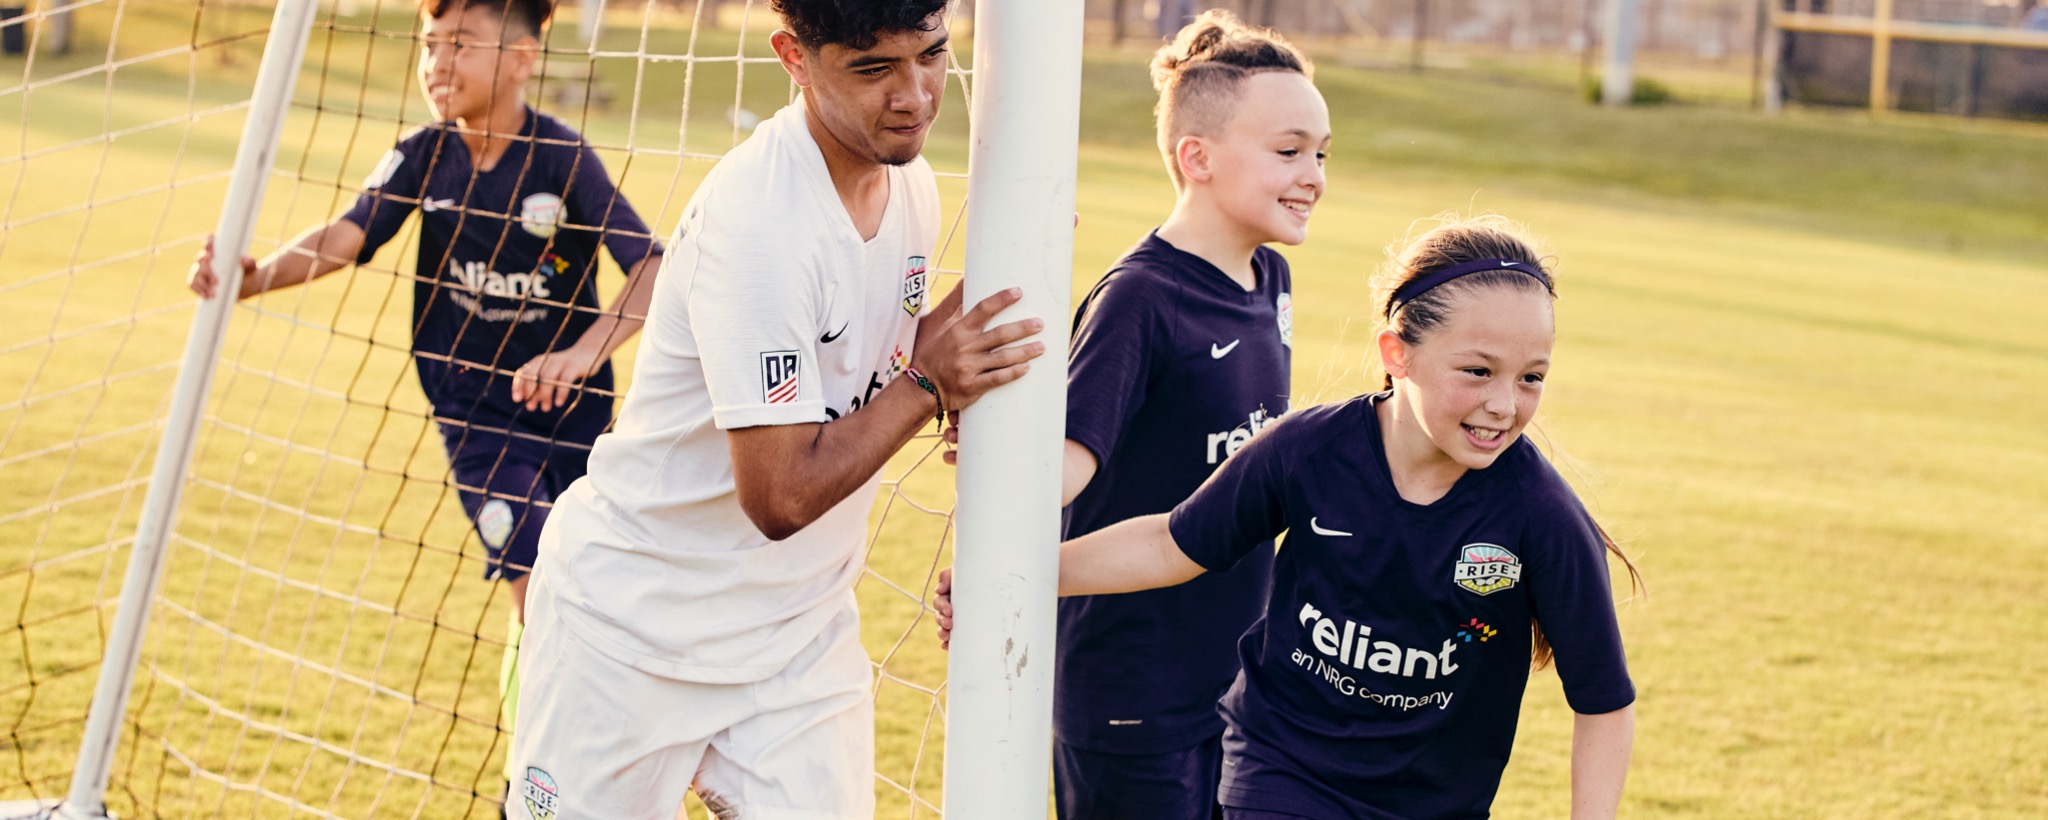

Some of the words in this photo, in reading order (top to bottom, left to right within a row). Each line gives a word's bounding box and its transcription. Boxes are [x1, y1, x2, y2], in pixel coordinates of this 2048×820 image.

[1467, 563, 1509, 577] RISE
[1299, 602, 1459, 680] reliant
[1291, 648, 1314, 671] an
[1315, 659, 1356, 695] NRG
[1359, 687, 1453, 711] company
[530, 785, 552, 808] RISE
